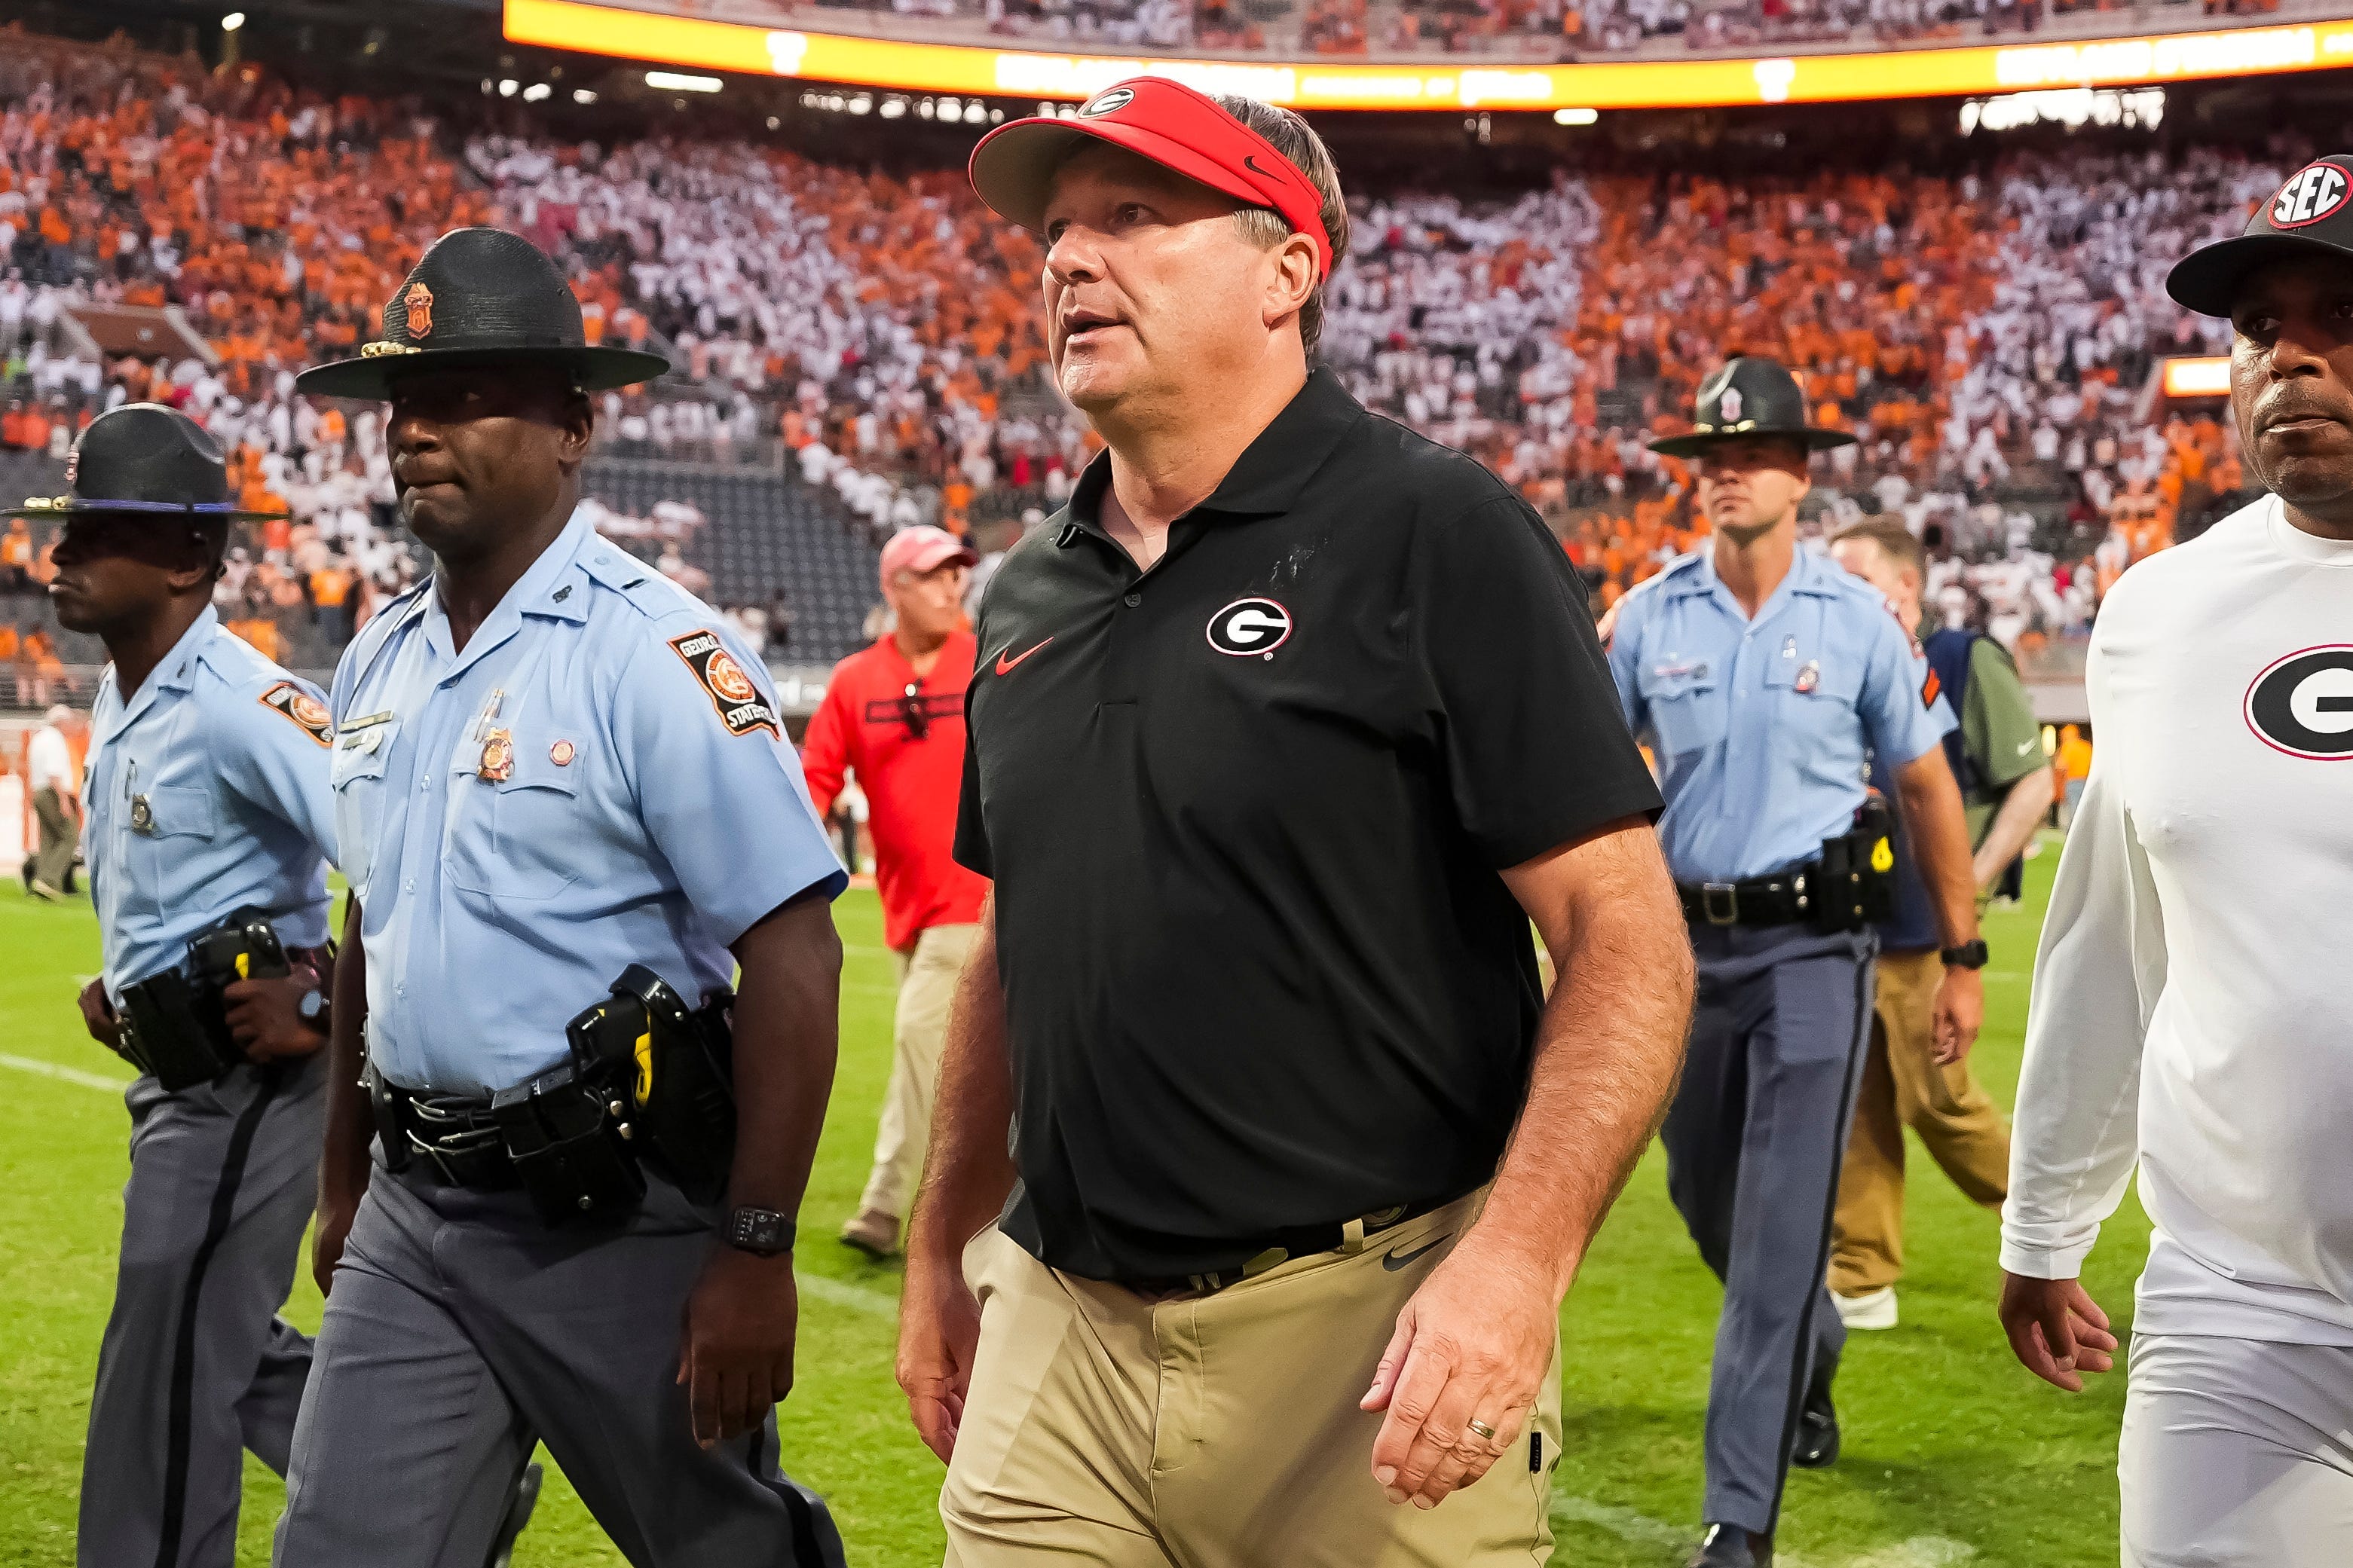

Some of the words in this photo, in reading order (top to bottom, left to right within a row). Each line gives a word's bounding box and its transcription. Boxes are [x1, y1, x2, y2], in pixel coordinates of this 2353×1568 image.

[1082, 90, 1132, 117] G
[2273, 167, 2345, 223] SEC
[1208, 601, 1288, 653] G
[2250, 650, 2353, 754] G
